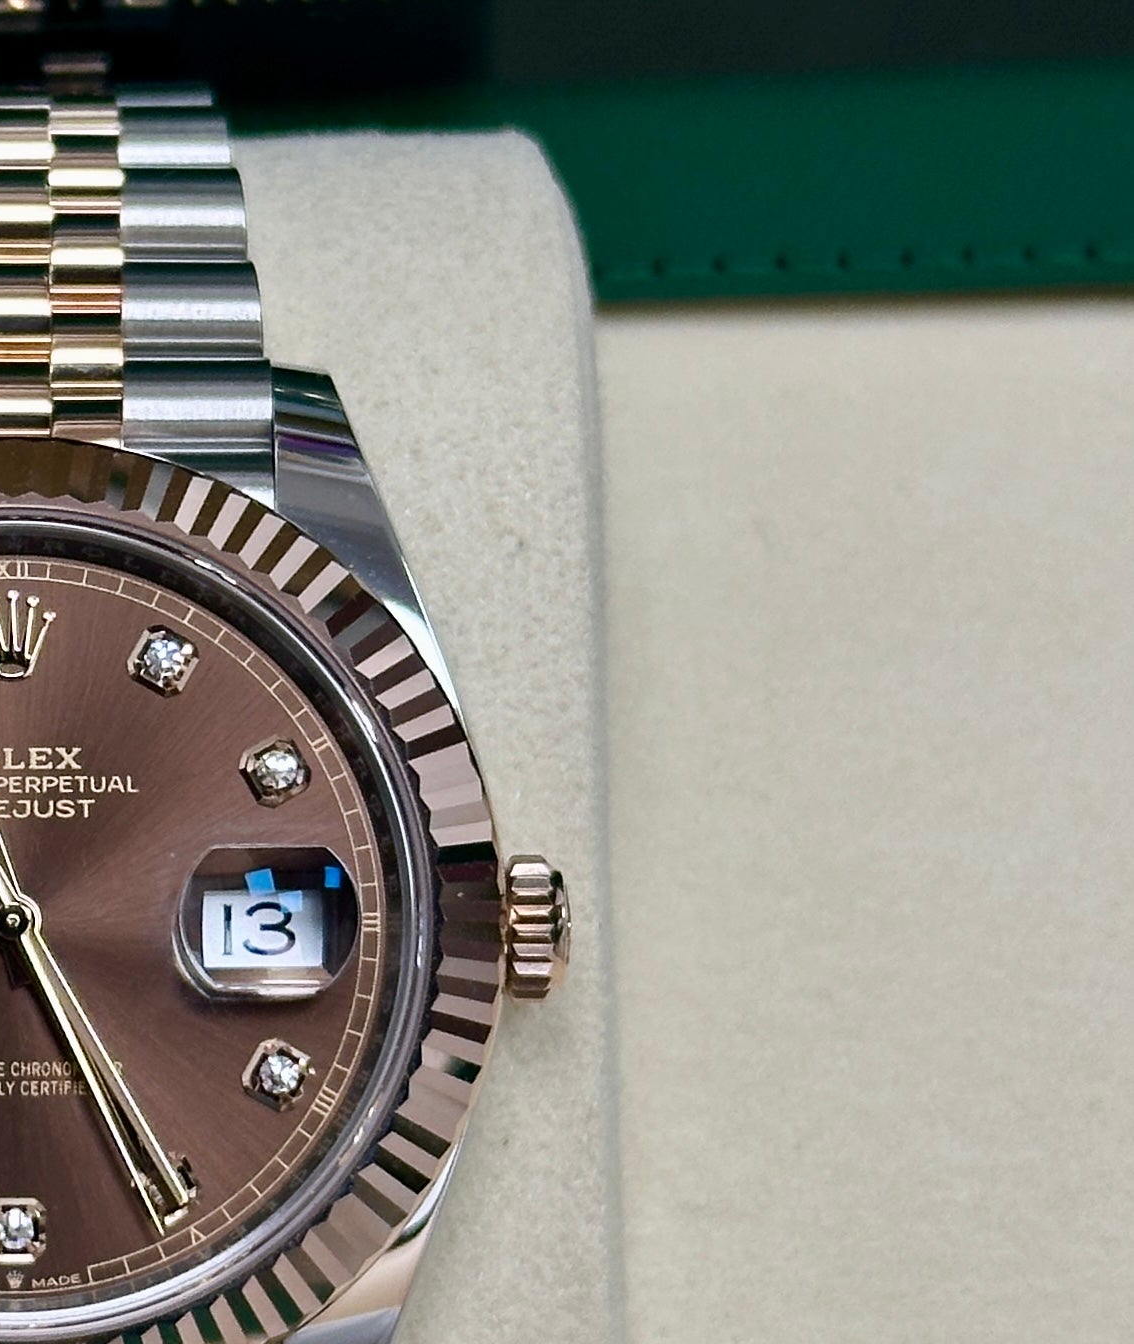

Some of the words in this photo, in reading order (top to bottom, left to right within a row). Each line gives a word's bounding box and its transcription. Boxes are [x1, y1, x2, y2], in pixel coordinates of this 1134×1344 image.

[221, 901, 296, 956] 13
[10, 1060, 123, 1077] CHRONOR
[20, 1080, 87, 1096] CERTIFIE
[31, 1273, 82, 1289] MADE
